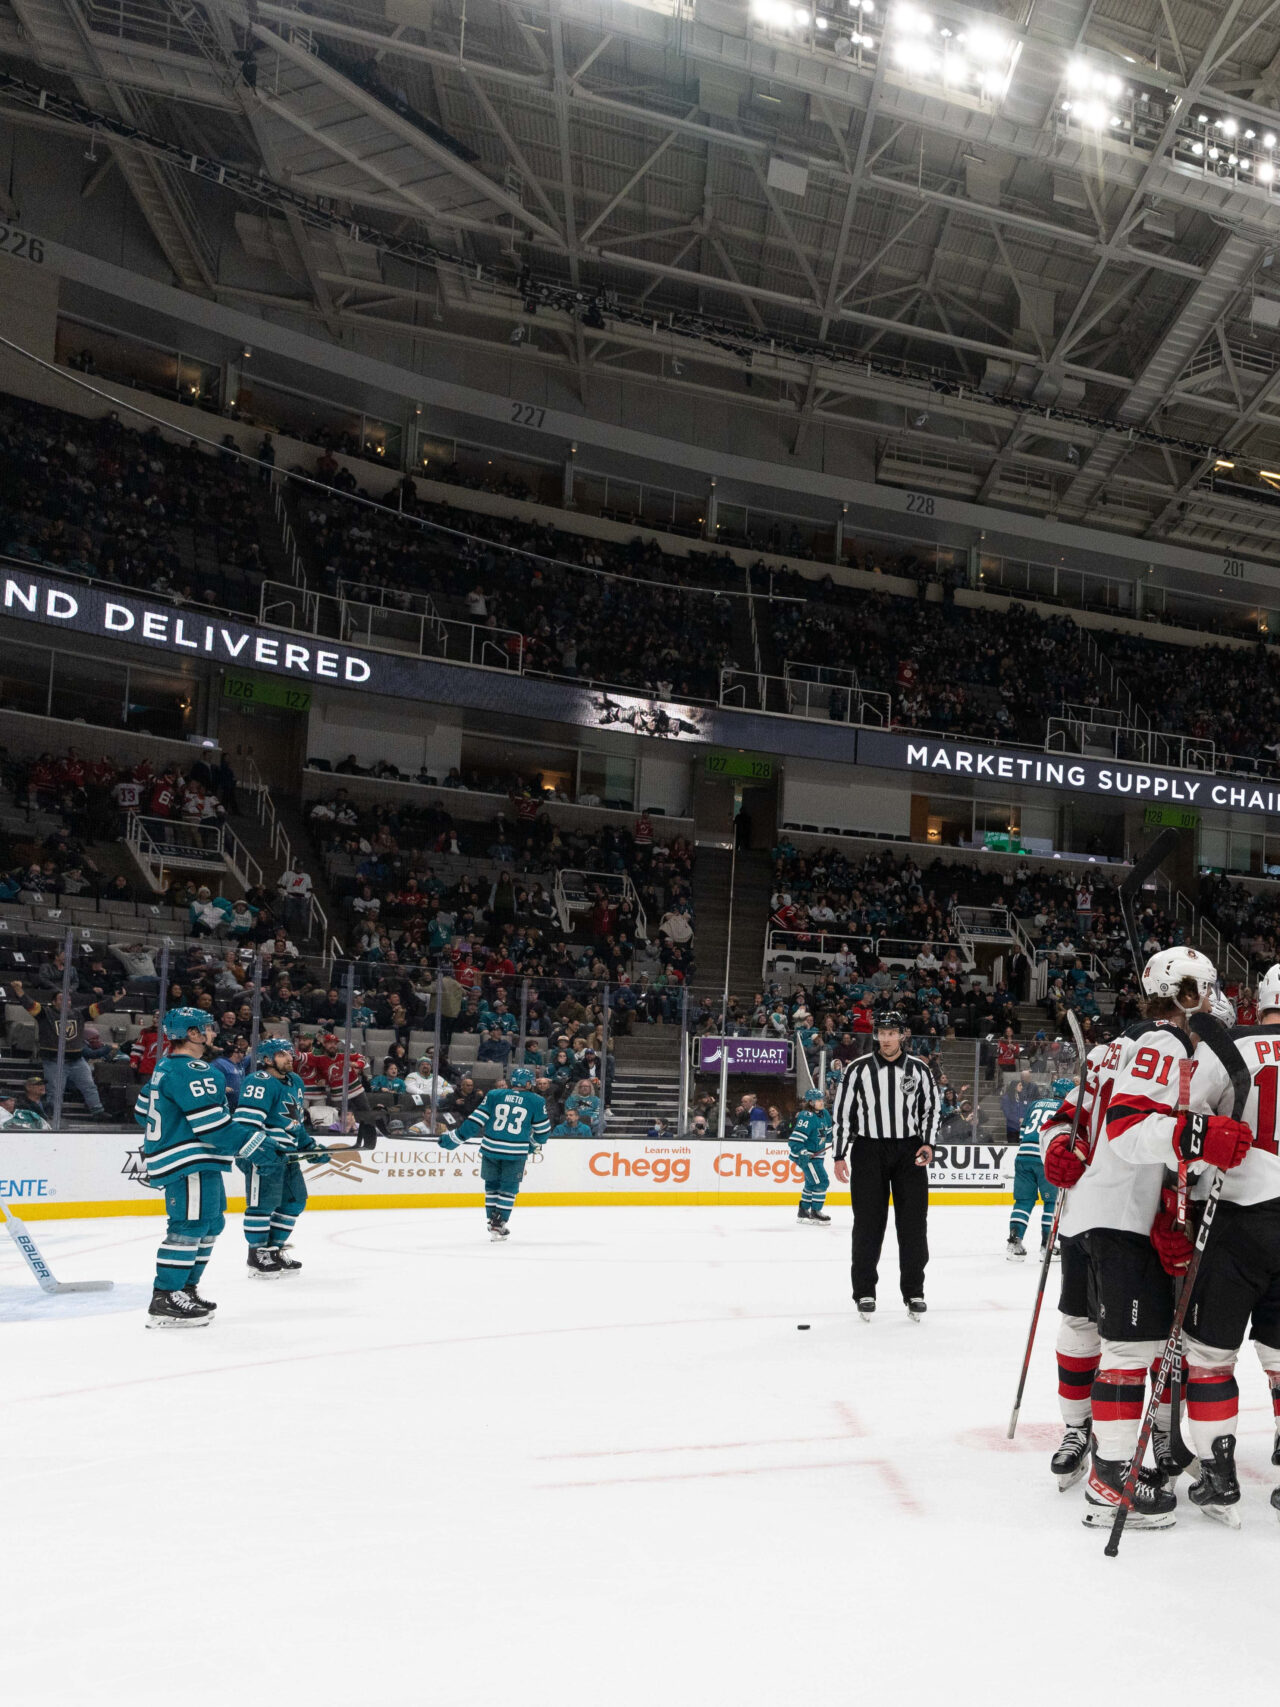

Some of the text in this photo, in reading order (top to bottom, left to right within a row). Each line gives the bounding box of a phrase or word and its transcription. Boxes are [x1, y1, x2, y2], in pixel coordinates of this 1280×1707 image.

[0, 226, 44, 263] 226
[512, 402, 545, 428] 227
[906, 494, 935, 515] 228
[1223, 560, 1244, 578] 201
[104, 603, 371, 681] DELIVERED
[907, 744, 1085, 785] MARKETING
[1098, 770, 1200, 801] SUPPLY
[736, 1048, 784, 1058] STUART
[1131, 1047, 1174, 1086] 91
[189, 1078, 217, 1097] 65
[243, 1085, 265, 1099] 38
[297, 1088, 303, 1098] A
[504, 1094, 524, 1104] NIETO
[493, 1103, 528, 1135] 83
[797, 1119, 809, 1128] 94
[1191, 1114, 1203, 1155] CC
[644, 1146, 691, 1154] Learn with
[765, 1147, 789, 1155] Learn
[388, 1169, 445, 1177] RESORT
[453, 1169, 463, 1177] &
[589, 1152, 690, 1183] Chegg
[1195, 1168, 1225, 1251] CCM
[1146, 1337, 1177, 1428] JETSPEED
[1091, 1479, 1121, 1505] CC
